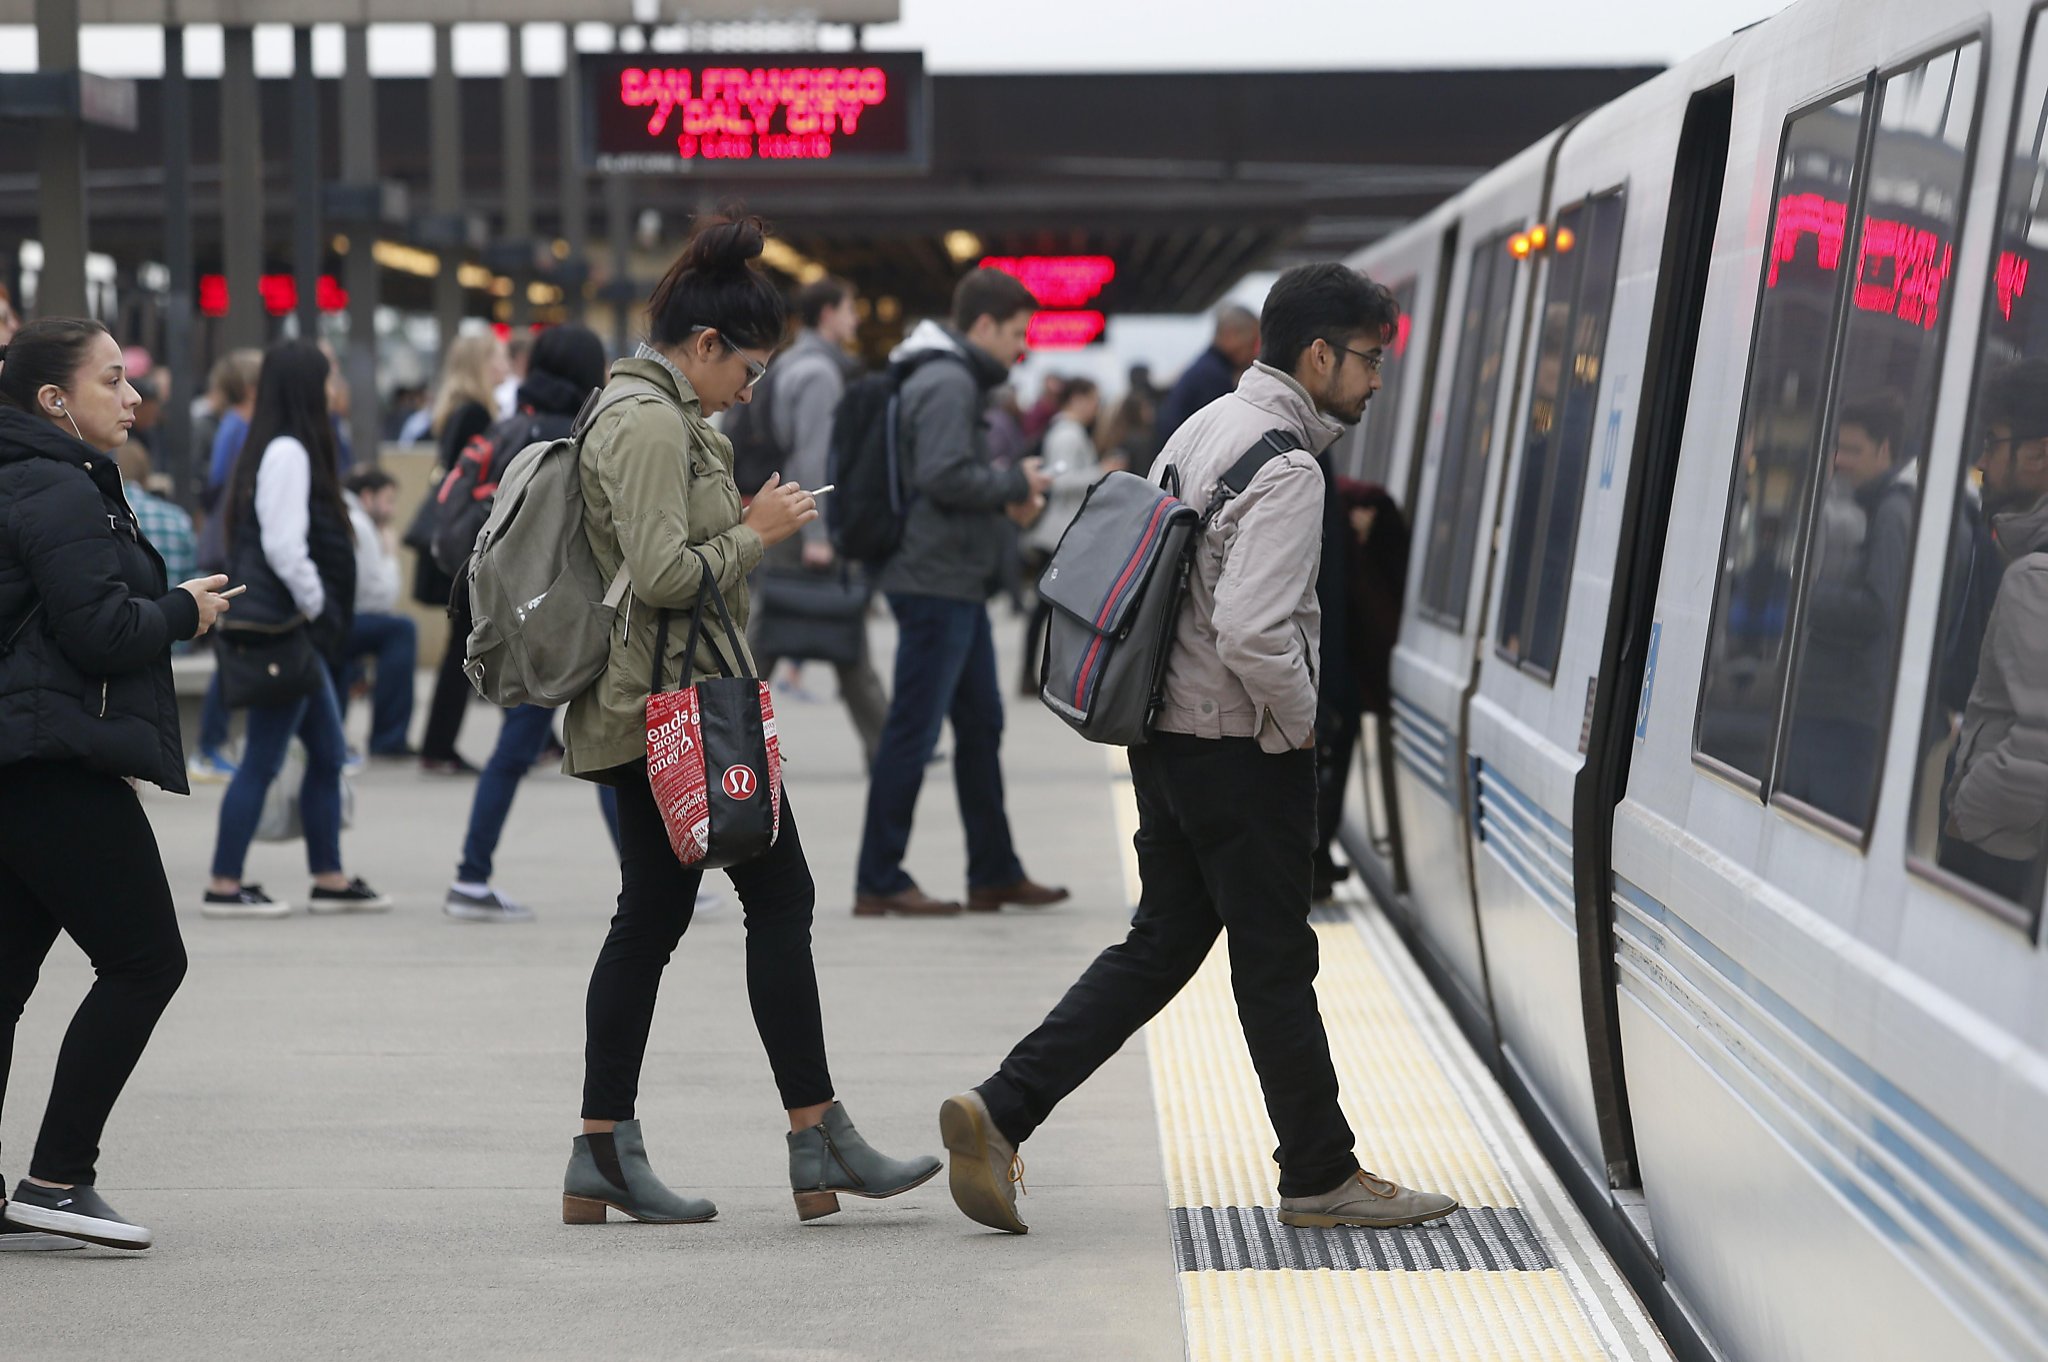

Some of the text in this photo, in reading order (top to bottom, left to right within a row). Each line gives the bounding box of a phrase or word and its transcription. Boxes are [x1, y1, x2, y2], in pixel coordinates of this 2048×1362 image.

[621, 67, 886, 106] SAN FRANCISCO
[683, 99, 777, 135] DALY
[786, 100, 864, 135] CITY
[646, 709, 689, 743] ends
[653, 729, 681, 752] more
[648, 747, 679, 777] oney
[675, 791, 708, 820] opposite
